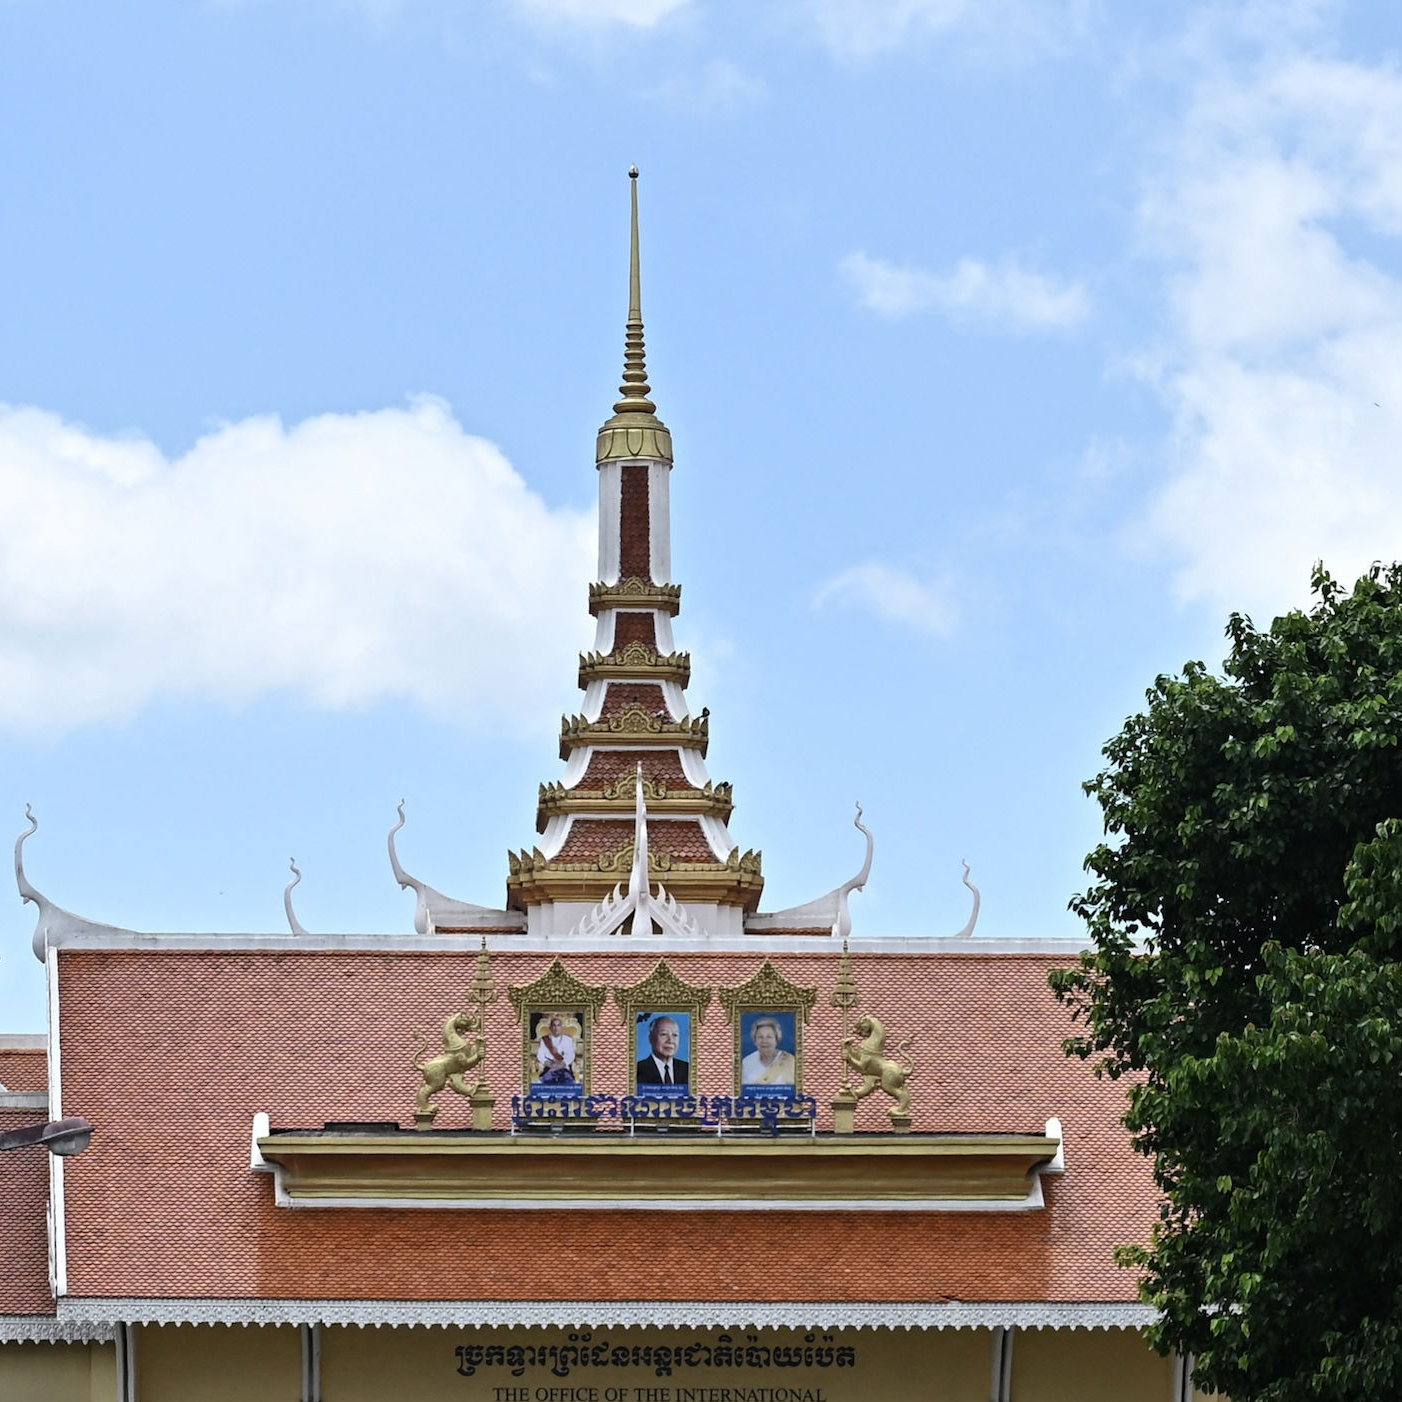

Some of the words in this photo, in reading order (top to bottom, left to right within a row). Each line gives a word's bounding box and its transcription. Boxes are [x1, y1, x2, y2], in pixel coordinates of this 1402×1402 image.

[493, 1388, 529, 1402] THE
[535, 1387, 599, 1402] OFFICE
[605, 1387, 629, 1402] OF
[634, 1388, 671, 1402] THE
[676, 1388, 827, 1402] INTERNATIONAL
